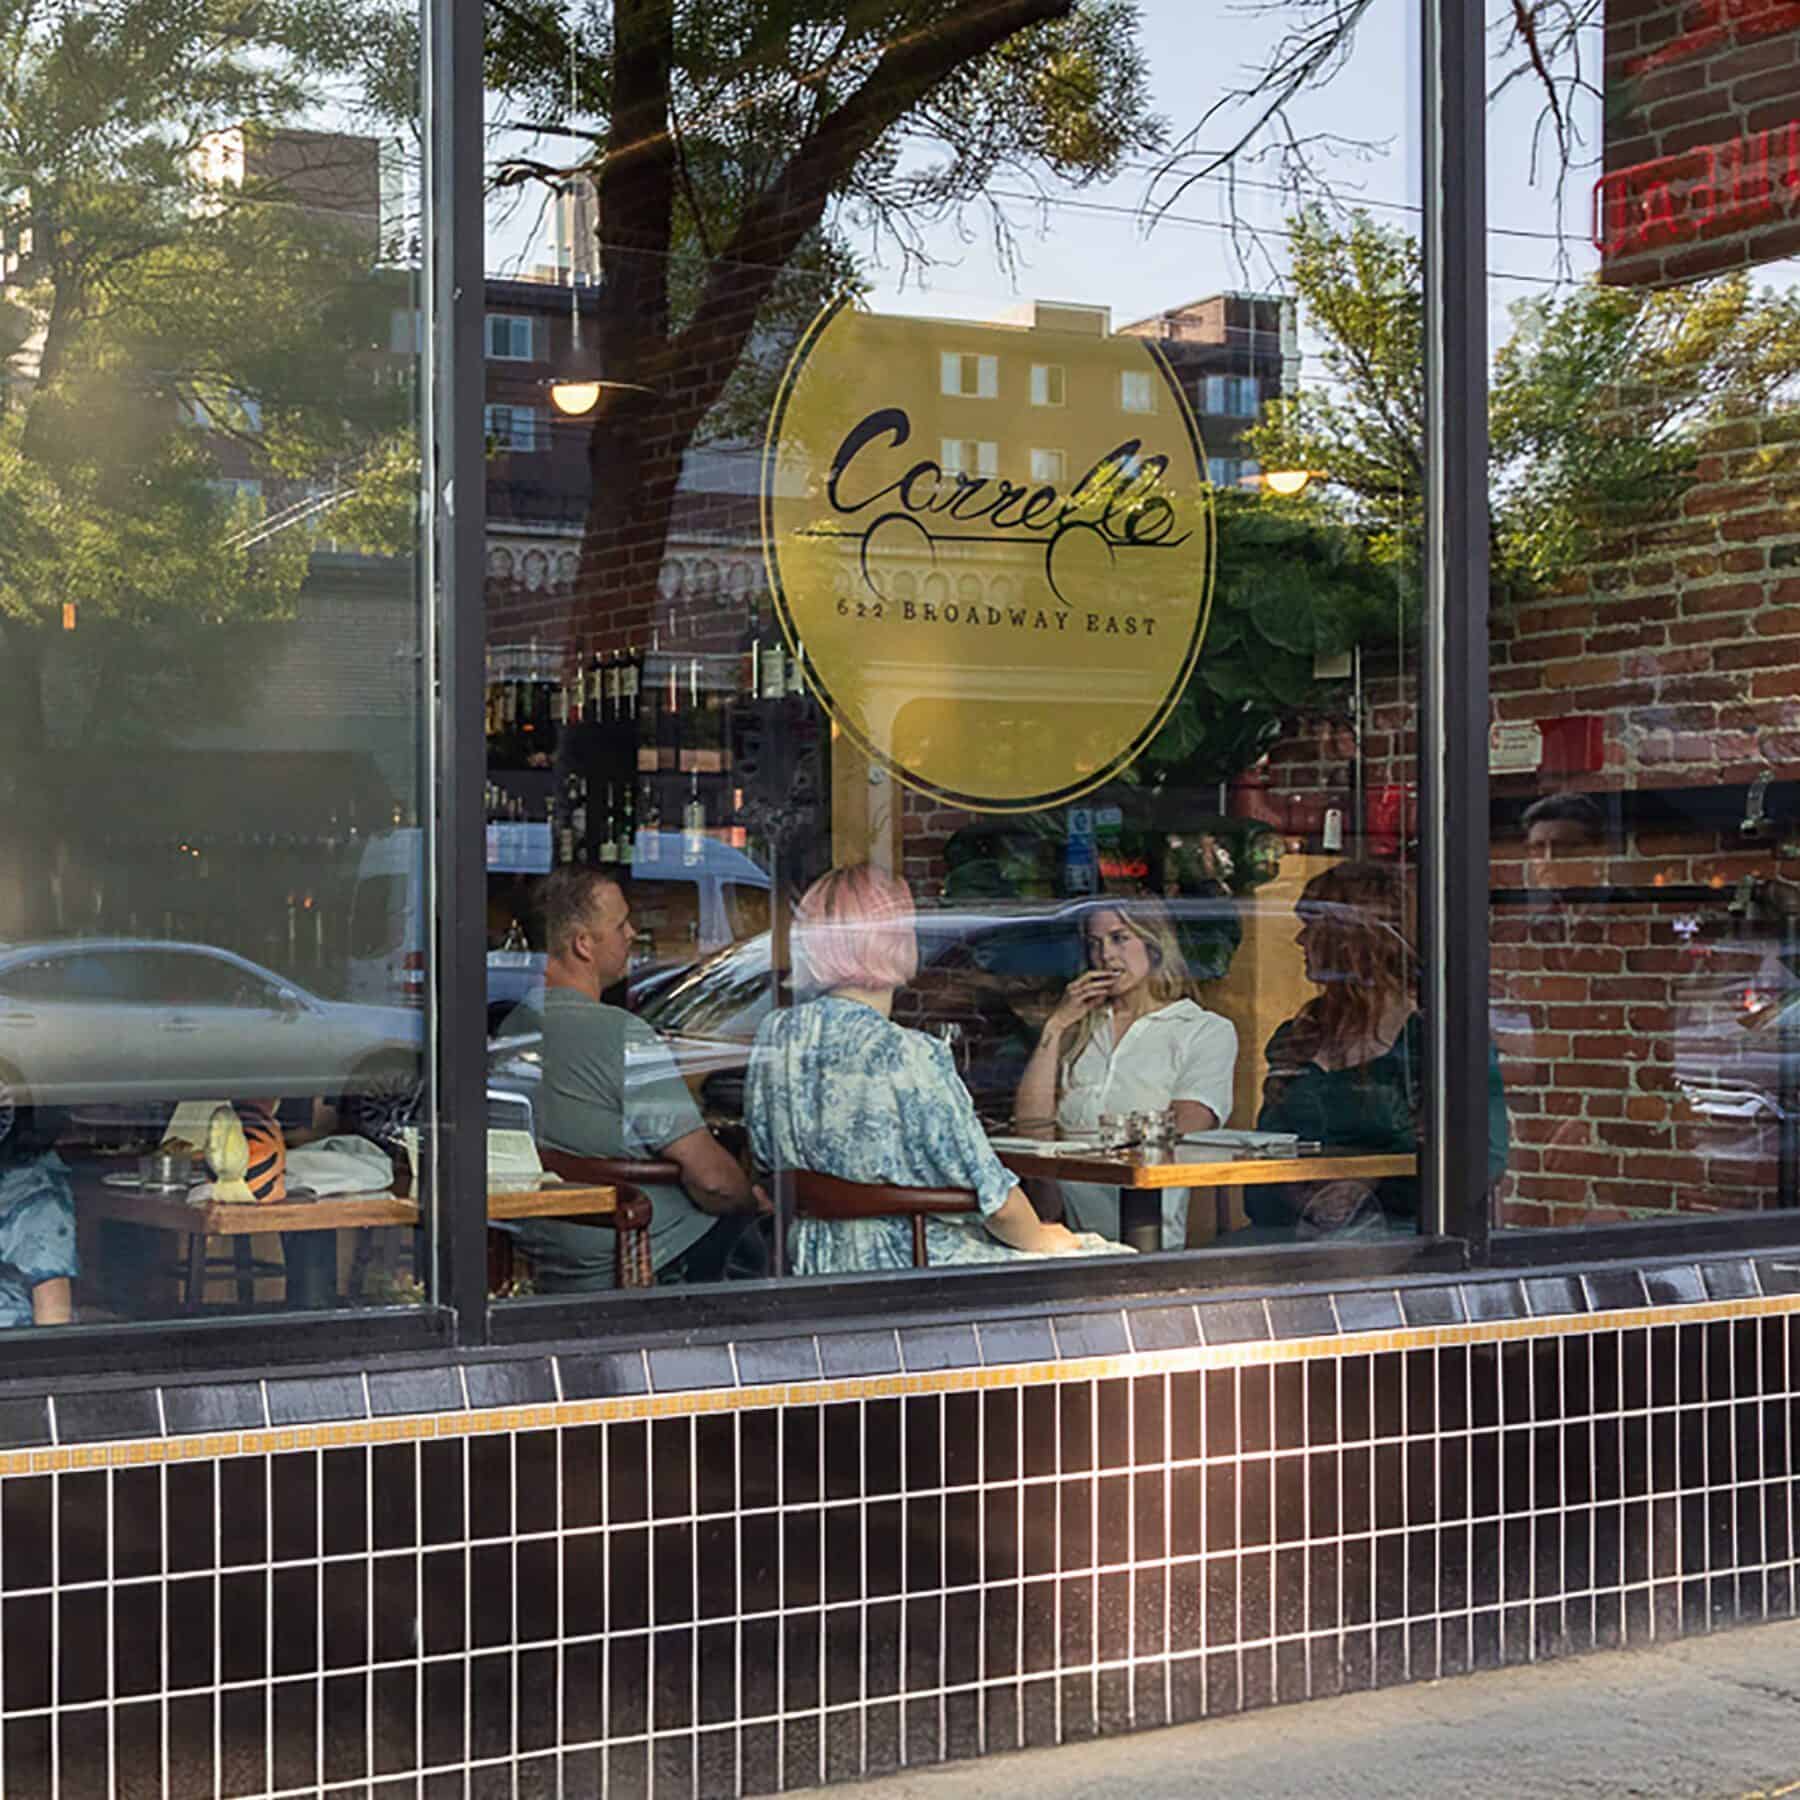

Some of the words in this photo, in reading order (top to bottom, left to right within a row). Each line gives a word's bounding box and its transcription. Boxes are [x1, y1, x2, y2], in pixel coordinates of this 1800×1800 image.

[828, 408, 1182, 546] Carrello
[837, 598, 883, 618] 622
[903, 601, 1069, 630] BROADWAY
[1086, 613, 1157, 636] EAST
